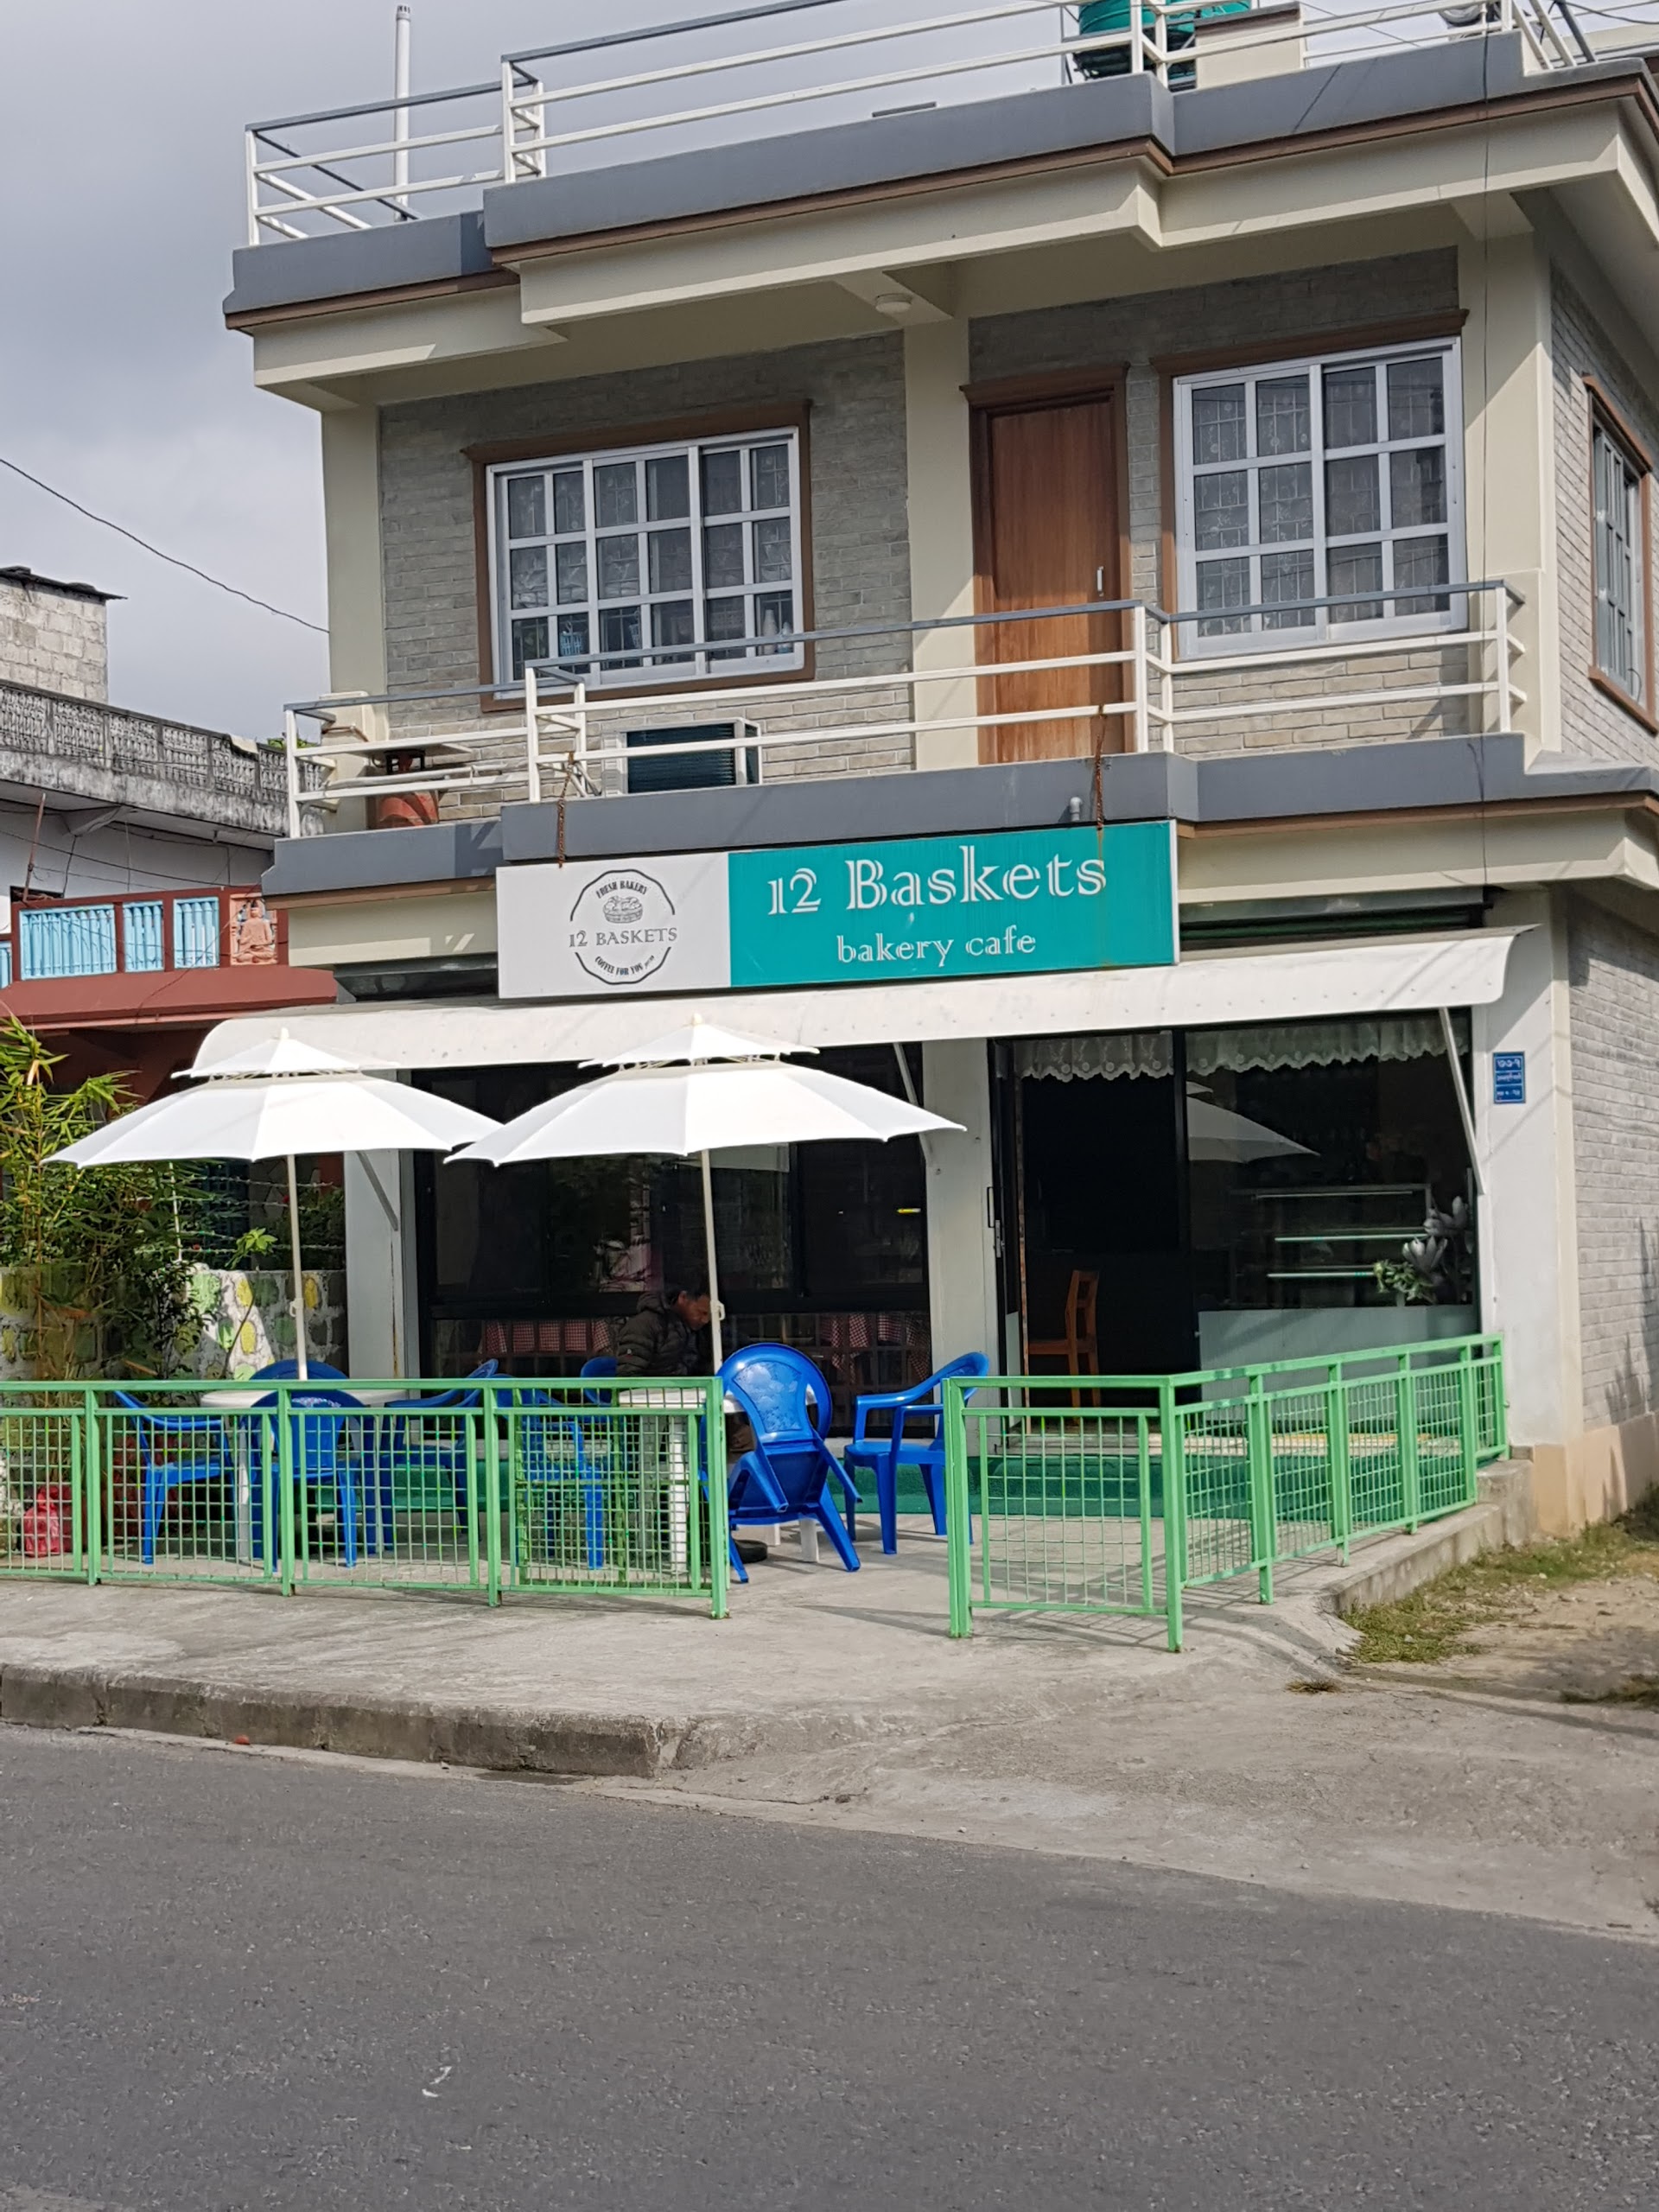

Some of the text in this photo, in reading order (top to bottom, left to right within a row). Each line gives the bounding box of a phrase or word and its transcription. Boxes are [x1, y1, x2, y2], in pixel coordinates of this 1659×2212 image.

[767, 845, 1107, 916] 12 Baskets
[569, 927, 677, 948] 12 BASKETS
[836, 925, 1037, 968] bakery cafe
